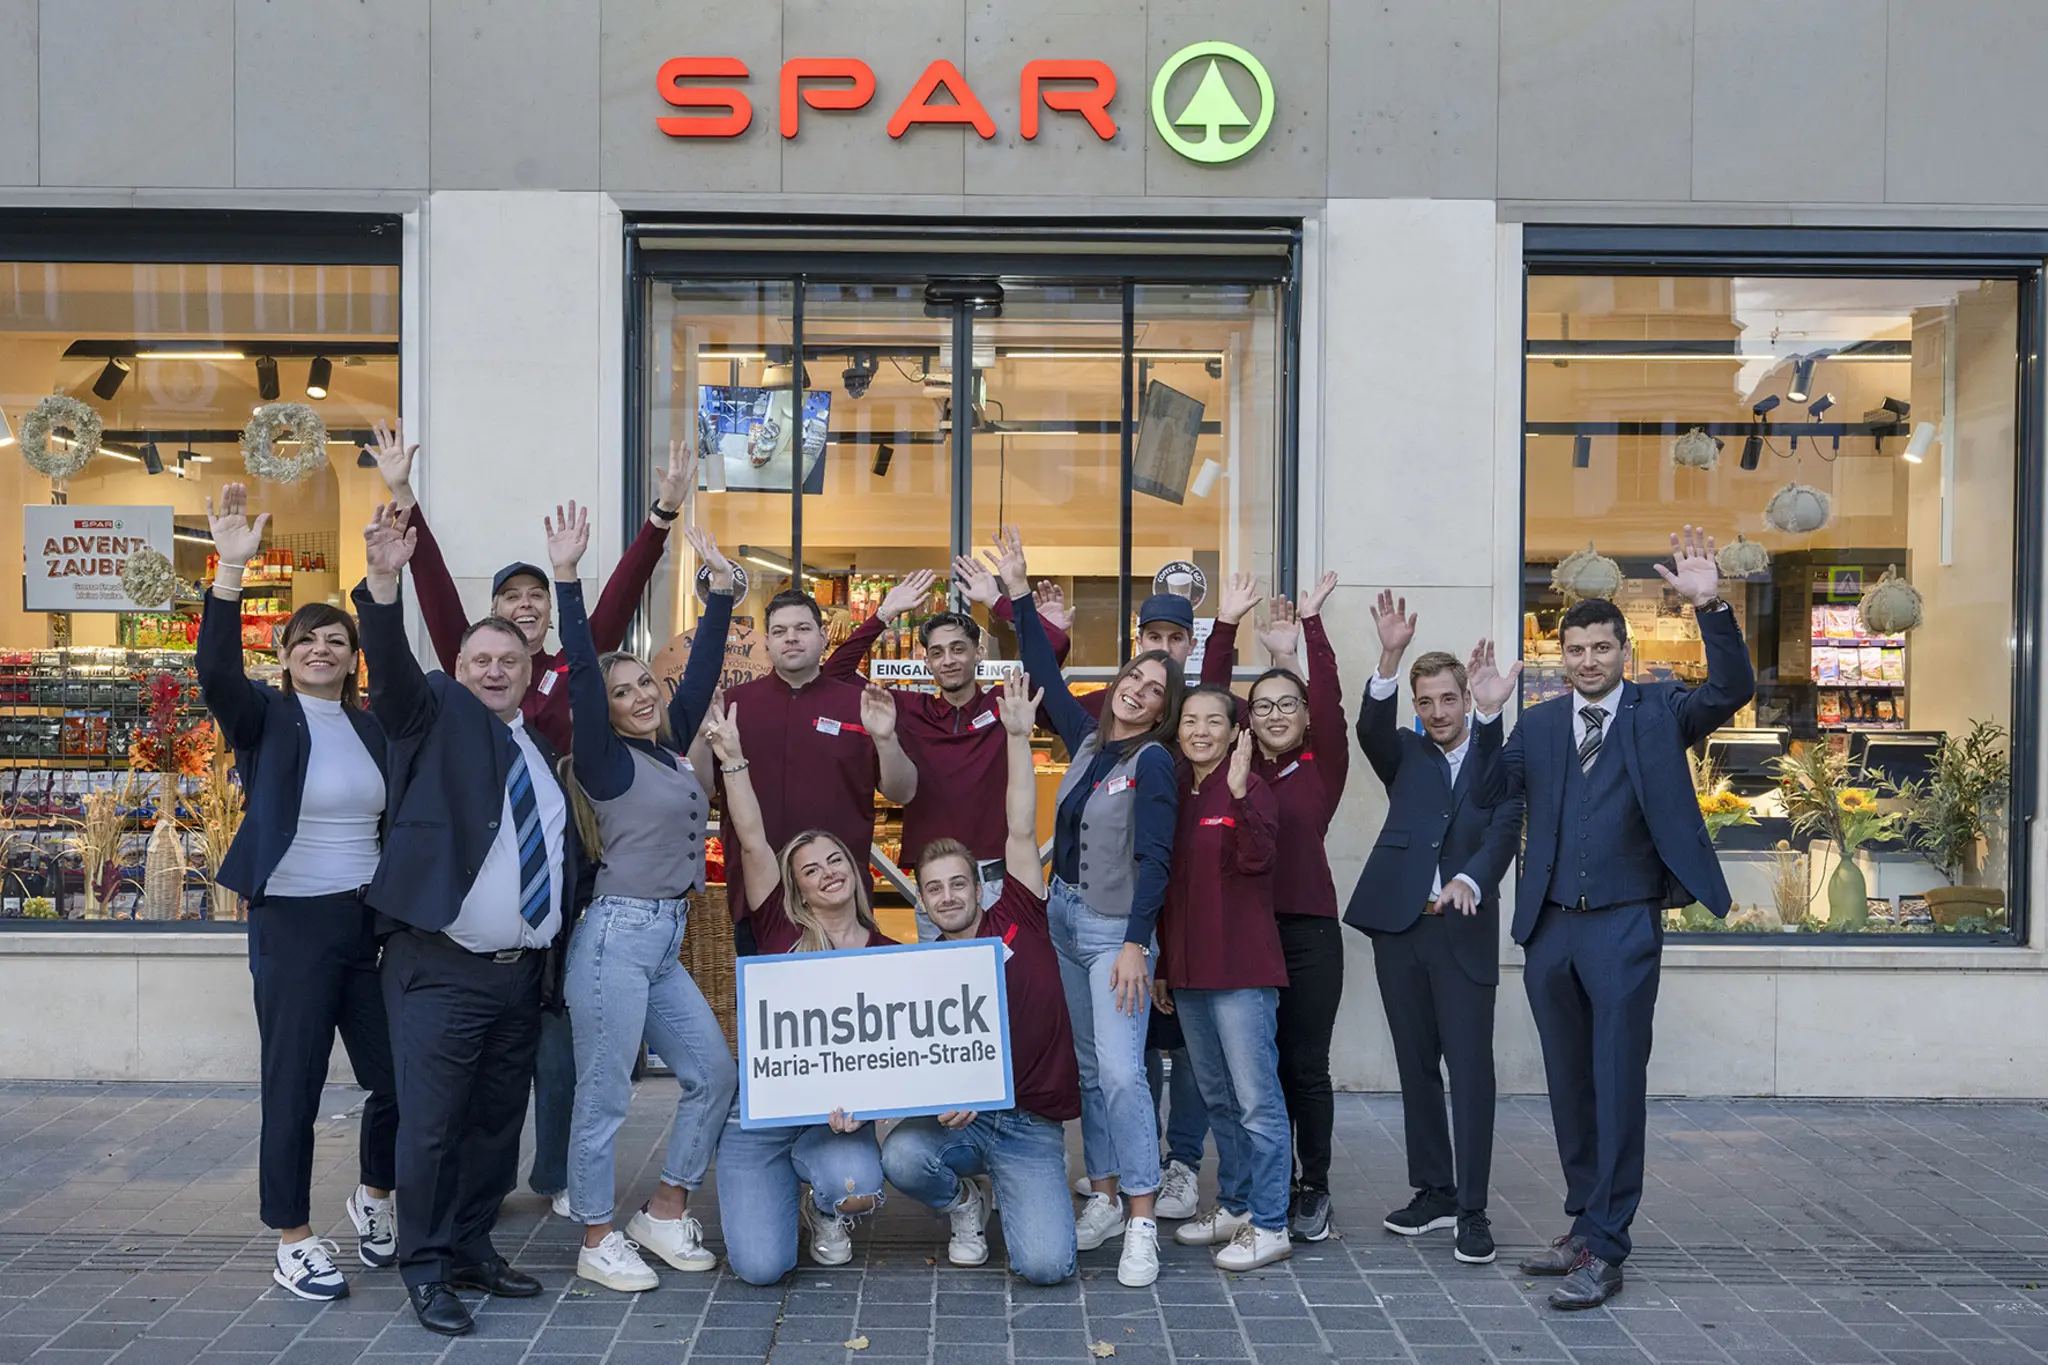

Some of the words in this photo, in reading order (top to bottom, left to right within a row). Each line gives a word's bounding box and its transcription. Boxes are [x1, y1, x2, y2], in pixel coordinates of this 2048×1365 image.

[656, 57, 1118, 141] SPAR
[80, 520, 113, 528] SPAR
[46, 558, 127, 578] ZAUBE
[877, 664, 933, 676] EINGAN
[759, 984, 990, 1050] Innsbruck
[753, 1040, 996, 1079] Maria-Theresien-Straße
